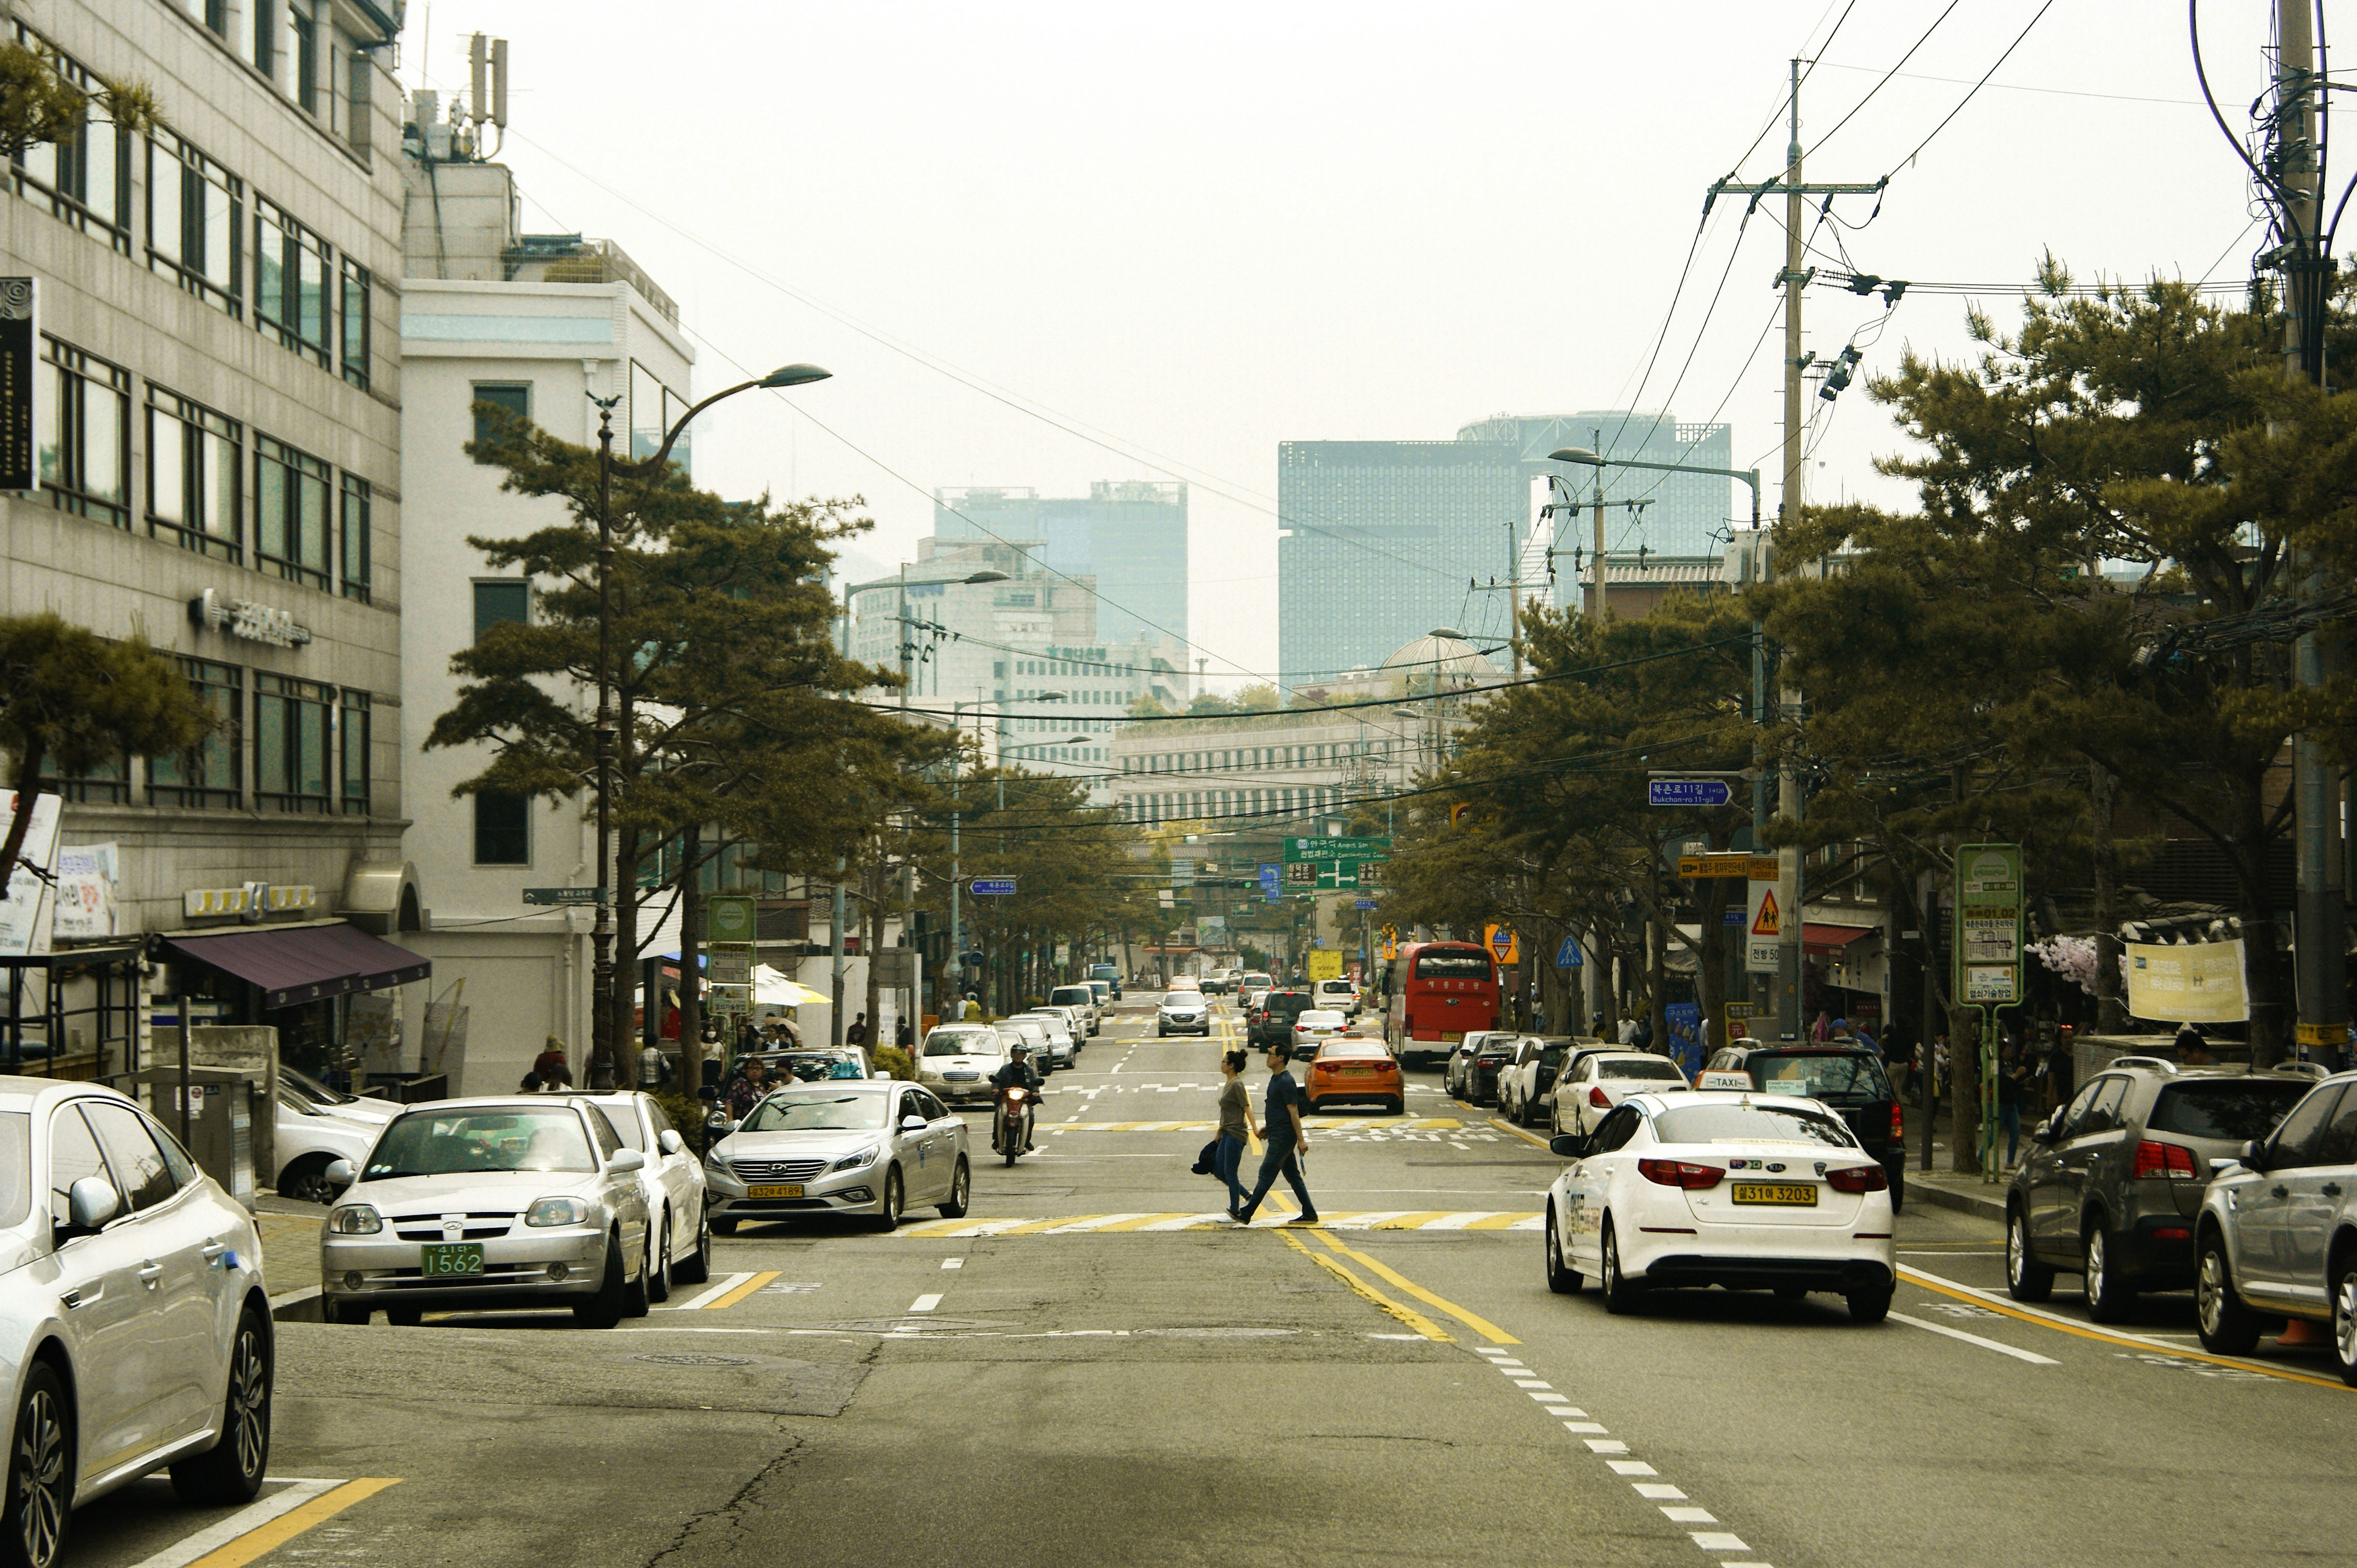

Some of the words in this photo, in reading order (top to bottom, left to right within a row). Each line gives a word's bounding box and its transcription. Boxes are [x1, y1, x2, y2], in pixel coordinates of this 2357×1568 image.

[1653, 784, 1703, 795] 북촌로11길
[1310, 840, 1336, 849] 안국역
[1300, 849, 1336, 858] 헌법재판소
[1753, 948, 1767, 960] 전방
[1428, 980, 1479, 990] 세종관광
[1969, 988, 2012, 998] 열쇠기술창업
[1732, 1025, 1742, 1035] 元
[1716, 1078, 1737, 1087] TAXI
[1769, 1163, 1784, 1172] KIA
[777, 1186, 799, 1196] 4189
[1776, 1187, 1811, 1201] 3203
[428, 1254, 481, 1273] 1562
